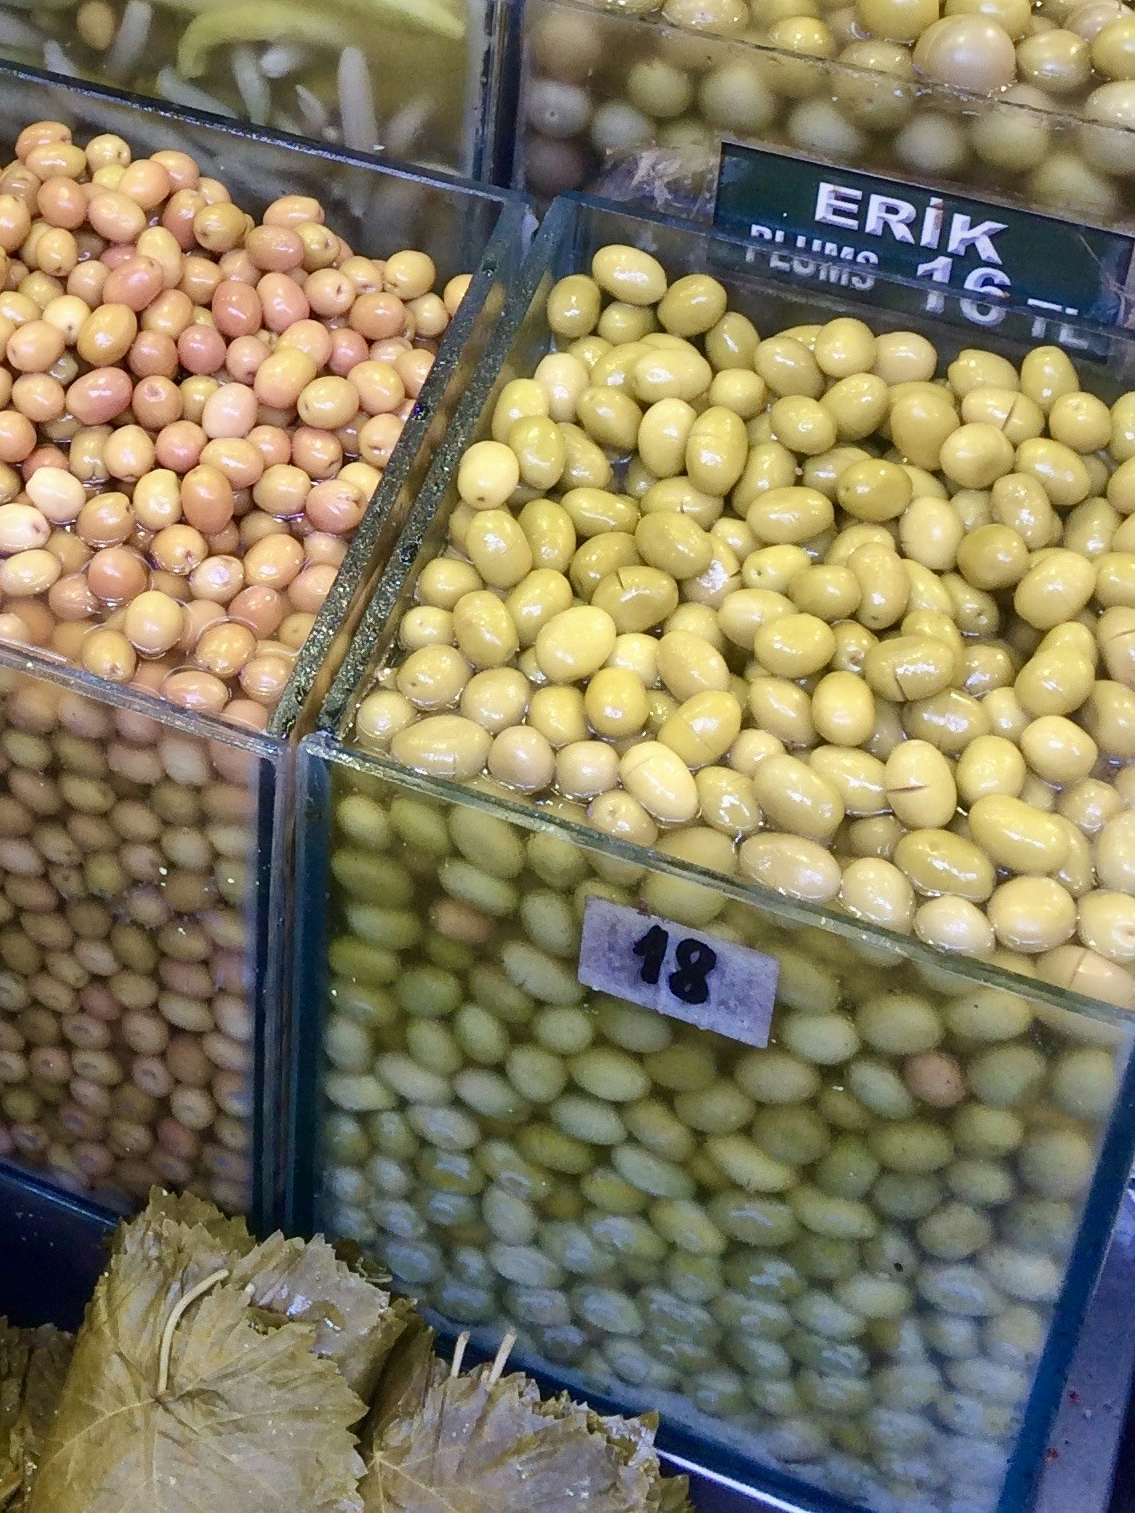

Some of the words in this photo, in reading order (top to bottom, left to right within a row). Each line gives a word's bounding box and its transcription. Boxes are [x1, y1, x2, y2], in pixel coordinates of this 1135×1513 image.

[813, 180, 1009, 265] ERİK
[916, 255, 1012, 326] 16
[632, 924, 717, 1005] 18
